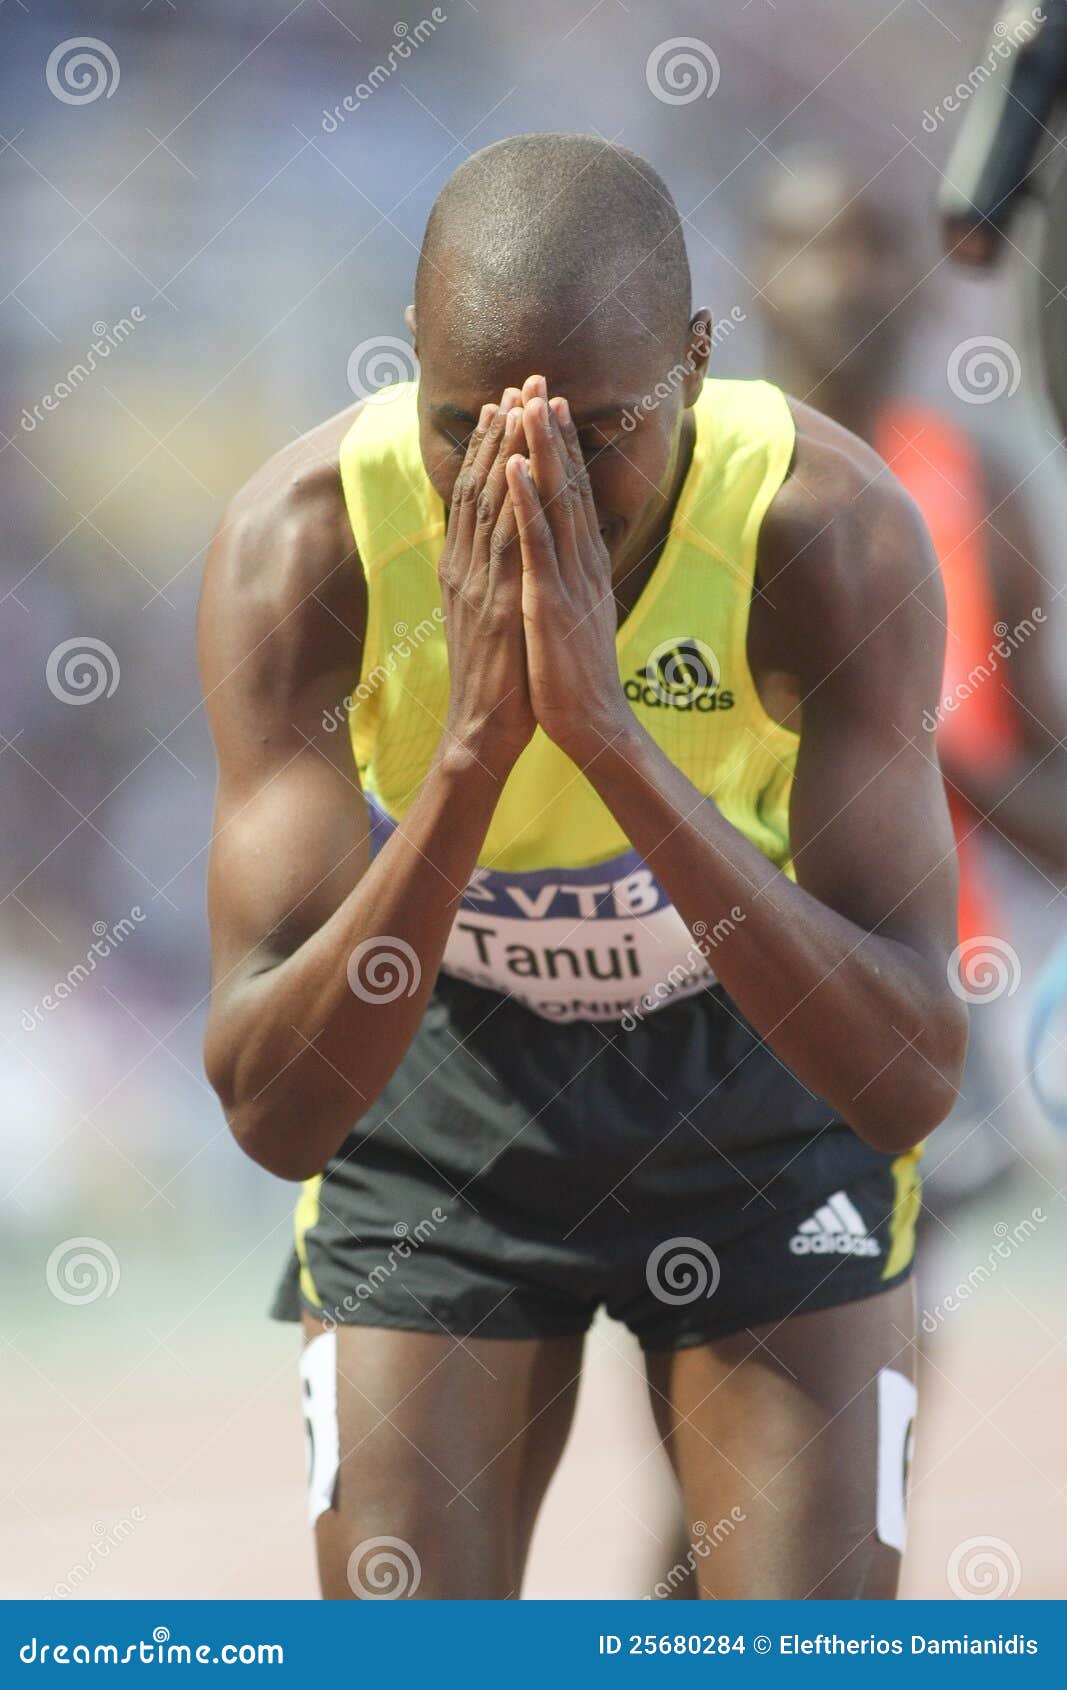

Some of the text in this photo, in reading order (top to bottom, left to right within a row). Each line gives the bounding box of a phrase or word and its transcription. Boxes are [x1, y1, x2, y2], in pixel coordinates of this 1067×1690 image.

[623, 680, 735, 712] adidas
[505, 869, 659, 918] VTB
[458, 922, 640, 981] Tanui
[789, 1233, 882, 1257] adidas
